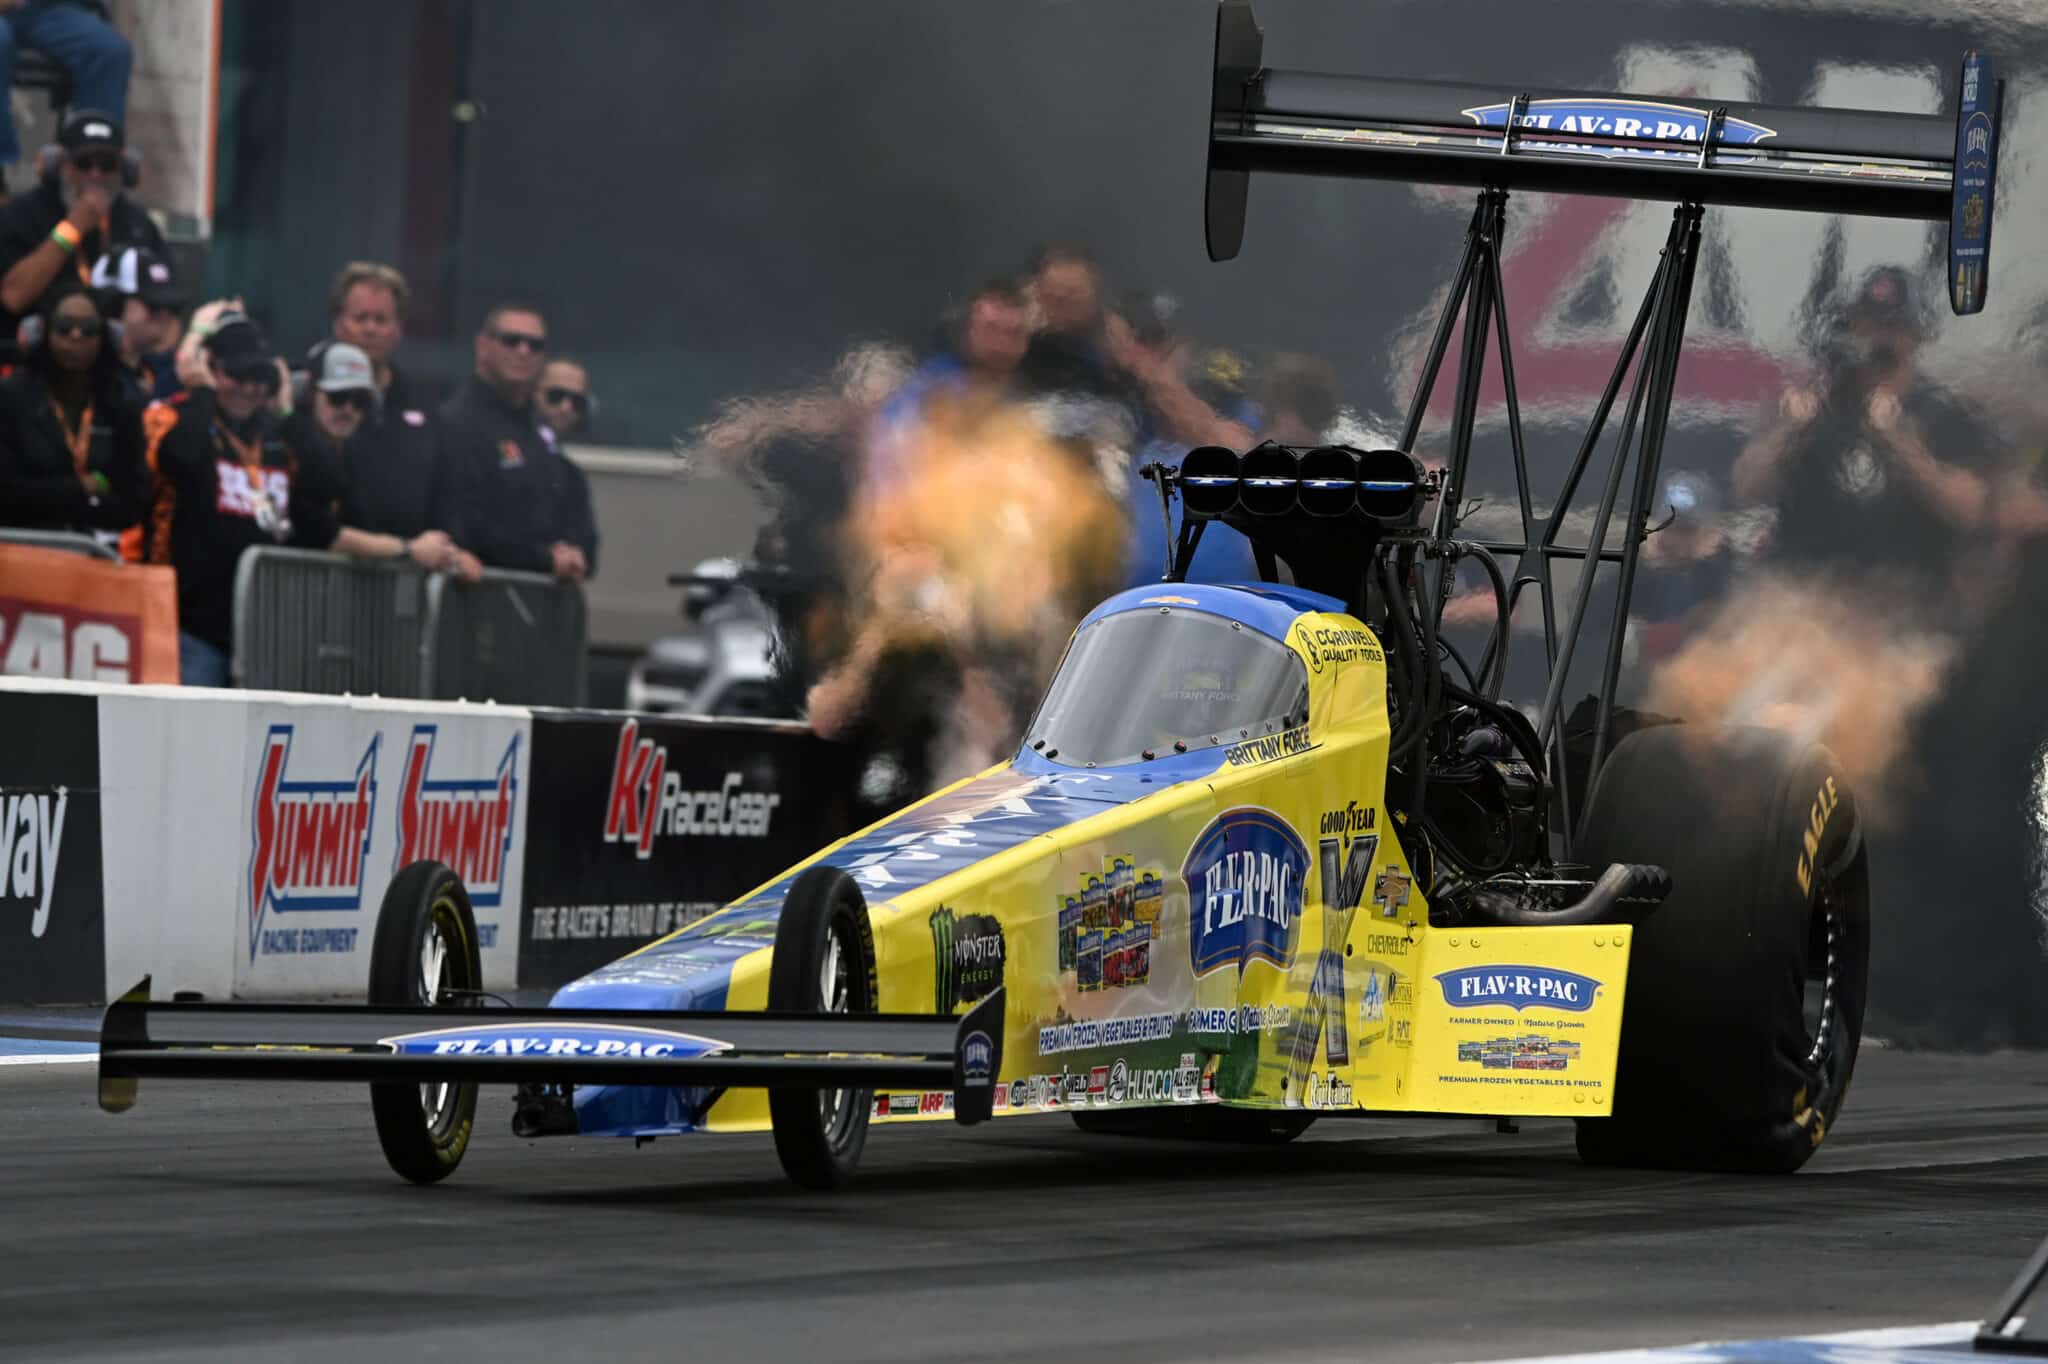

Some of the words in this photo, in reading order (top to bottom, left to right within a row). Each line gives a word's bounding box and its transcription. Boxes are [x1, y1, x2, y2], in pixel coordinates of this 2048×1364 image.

[0, 612, 130, 683] AG
[1323, 648, 1357, 661] QUALITY
[1360, 649, 1382, 661] TOOLS
[1224, 735, 1281, 766] BRITTANY
[1283, 726, 1311, 755] FORCE
[604, 718, 667, 858] K1
[655, 771, 780, 835] RaceGear
[253, 744, 368, 919] SUMMIT
[1797, 776, 1838, 897] EAGLE
[532, 907, 556, 939] THE
[262, 929, 298, 954] RACING
[301, 928, 358, 953] EQUIPMENT
[955, 933, 1001, 966] MONSTER
[1368, 934, 1409, 956] CHEVROLET
[961, 969, 993, 984] ENERGY
[1040, 1025, 1072, 1051] PREMIUM
[1073, 1022, 1100, 1046] FROZEN
[1101, 1018, 1141, 1043] VEGETABLES
[1149, 1014, 1173, 1037] FRUITS
[1450, 1017, 1482, 1025] FARMER
[1127, 1069, 1172, 1100] HURCO
[1439, 1076, 1478, 1084] PREMIUM
[1479, 1077, 1512, 1085] FROZEN
[1514, 1078, 1565, 1086] VEGETABLES
[1574, 1080, 1602, 1088] FRUITS
[921, 1092, 944, 1113] ARP
